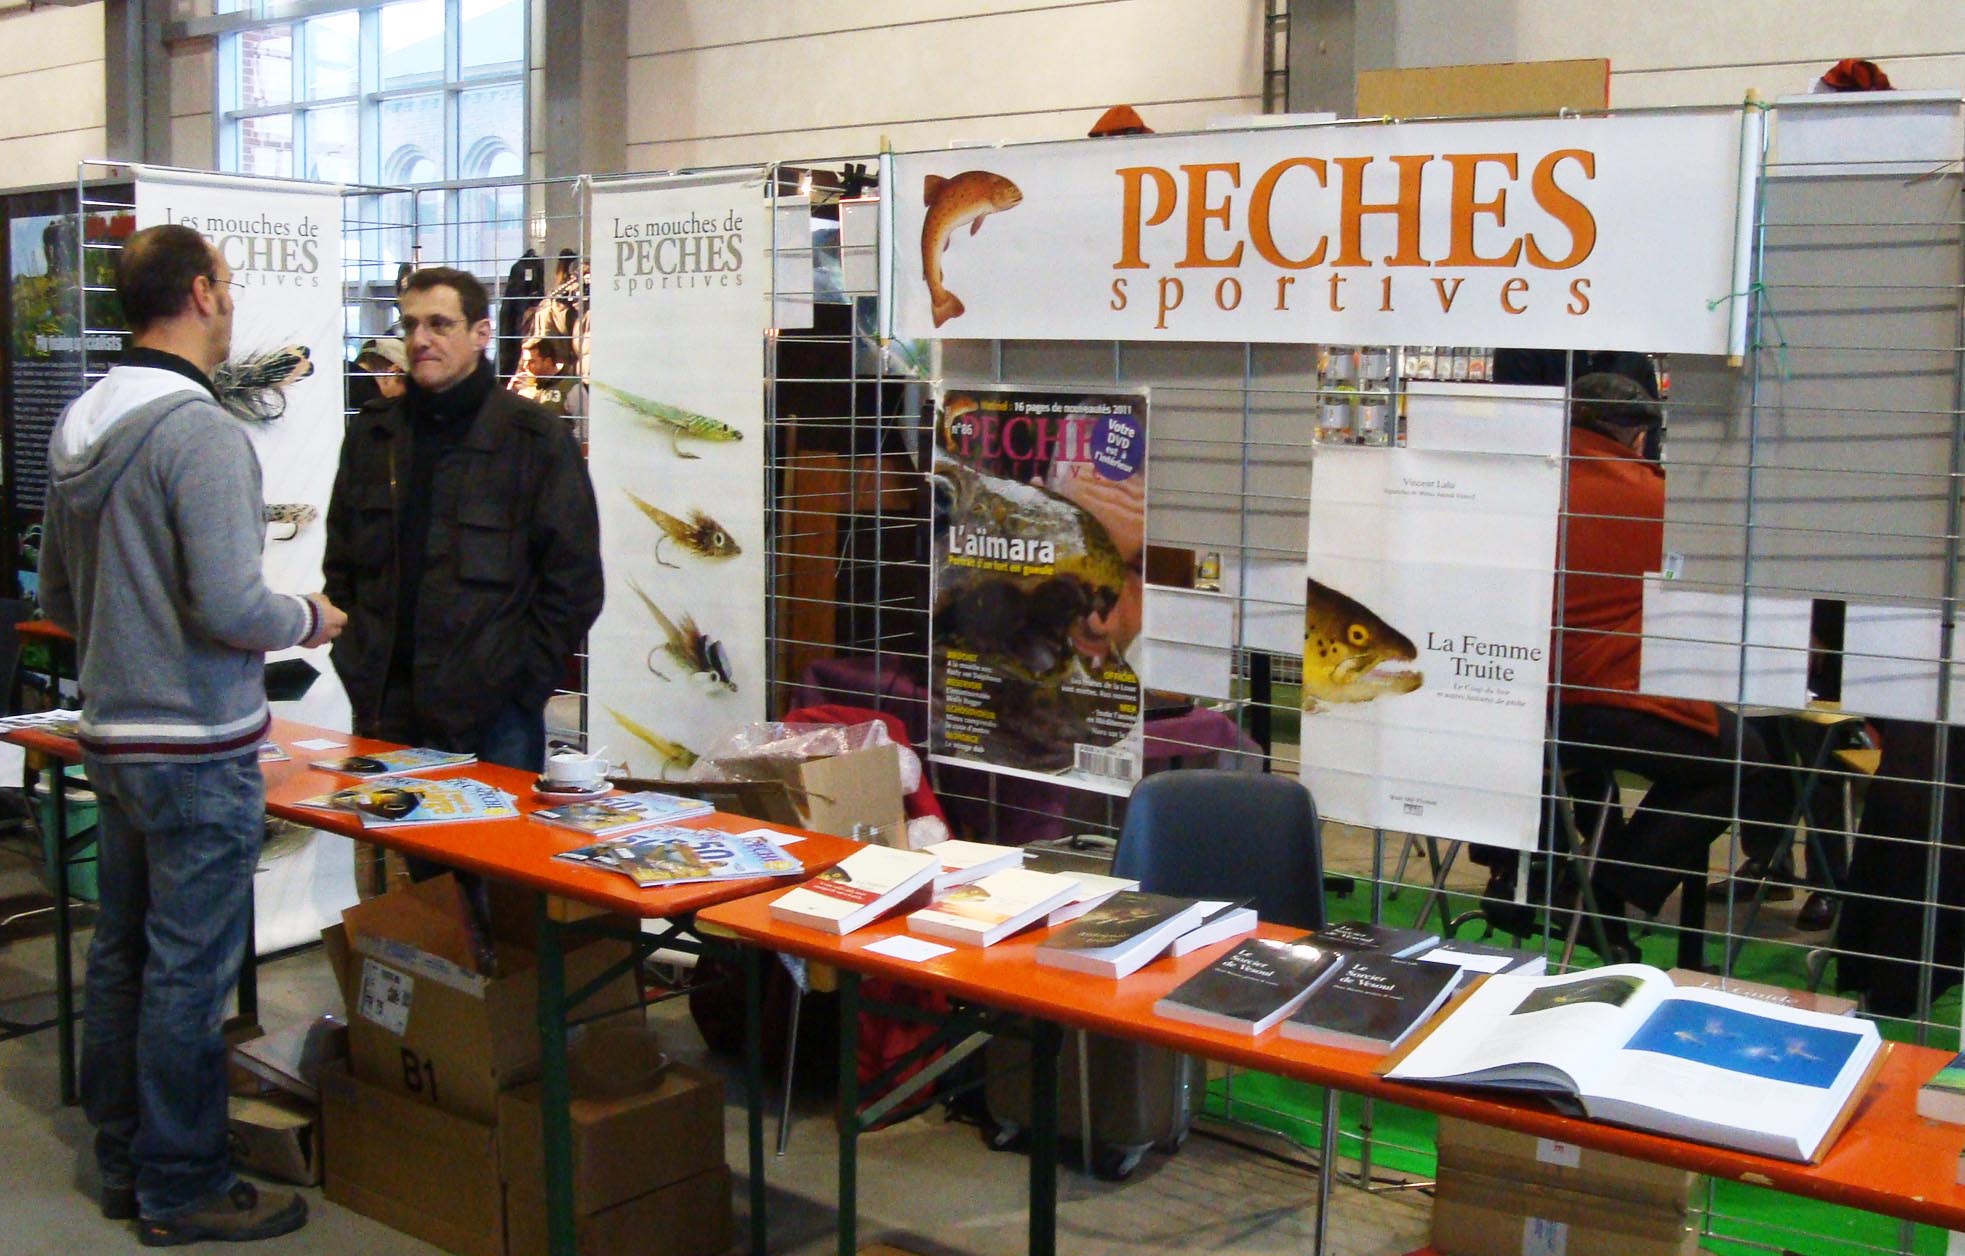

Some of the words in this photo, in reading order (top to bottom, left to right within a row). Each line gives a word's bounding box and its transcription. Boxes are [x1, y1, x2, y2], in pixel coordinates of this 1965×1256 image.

[165, 207, 199, 230] Les
[207, 213, 290, 235] mouches
[298, 216, 319, 237] de
[1113, 149, 1597, 270] PECHES
[613, 218, 640, 239] Les
[646, 211, 717, 236] mouches
[724, 209, 743, 231] de
[202, 234, 319, 274] CHES
[614, 234, 743, 276] PECHES
[245, 272, 319, 287] tives
[613, 274, 743, 296] sportives
[1110, 272, 1592, 329] sportives
[1014, 402, 1025, 412] 16
[1025, 403, 1050, 415] pages
[1051, 402, 1062, 413] de
[1063, 403, 1111, 415] nouveautés
[1113, 405, 1132, 415] 2011
[961, 415, 1097, 463] PECHE
[1107, 433, 1131, 449] DVD
[1108, 418, 1136, 438] Votre
[949, 525, 1055, 564] L'aïmara
[1427, 632, 1454, 652] La
[1462, 635, 1541, 661] Femme
[1450, 656, 1514, 681] Truite
[1240, 964, 1276, 977] Vesoul
[1345, 970, 1387, 982] Sorcier
[1351, 963, 1368, 971] Le
[1358, 979, 1396, 991] Vesoul
[401, 1047, 438, 1102] B1
